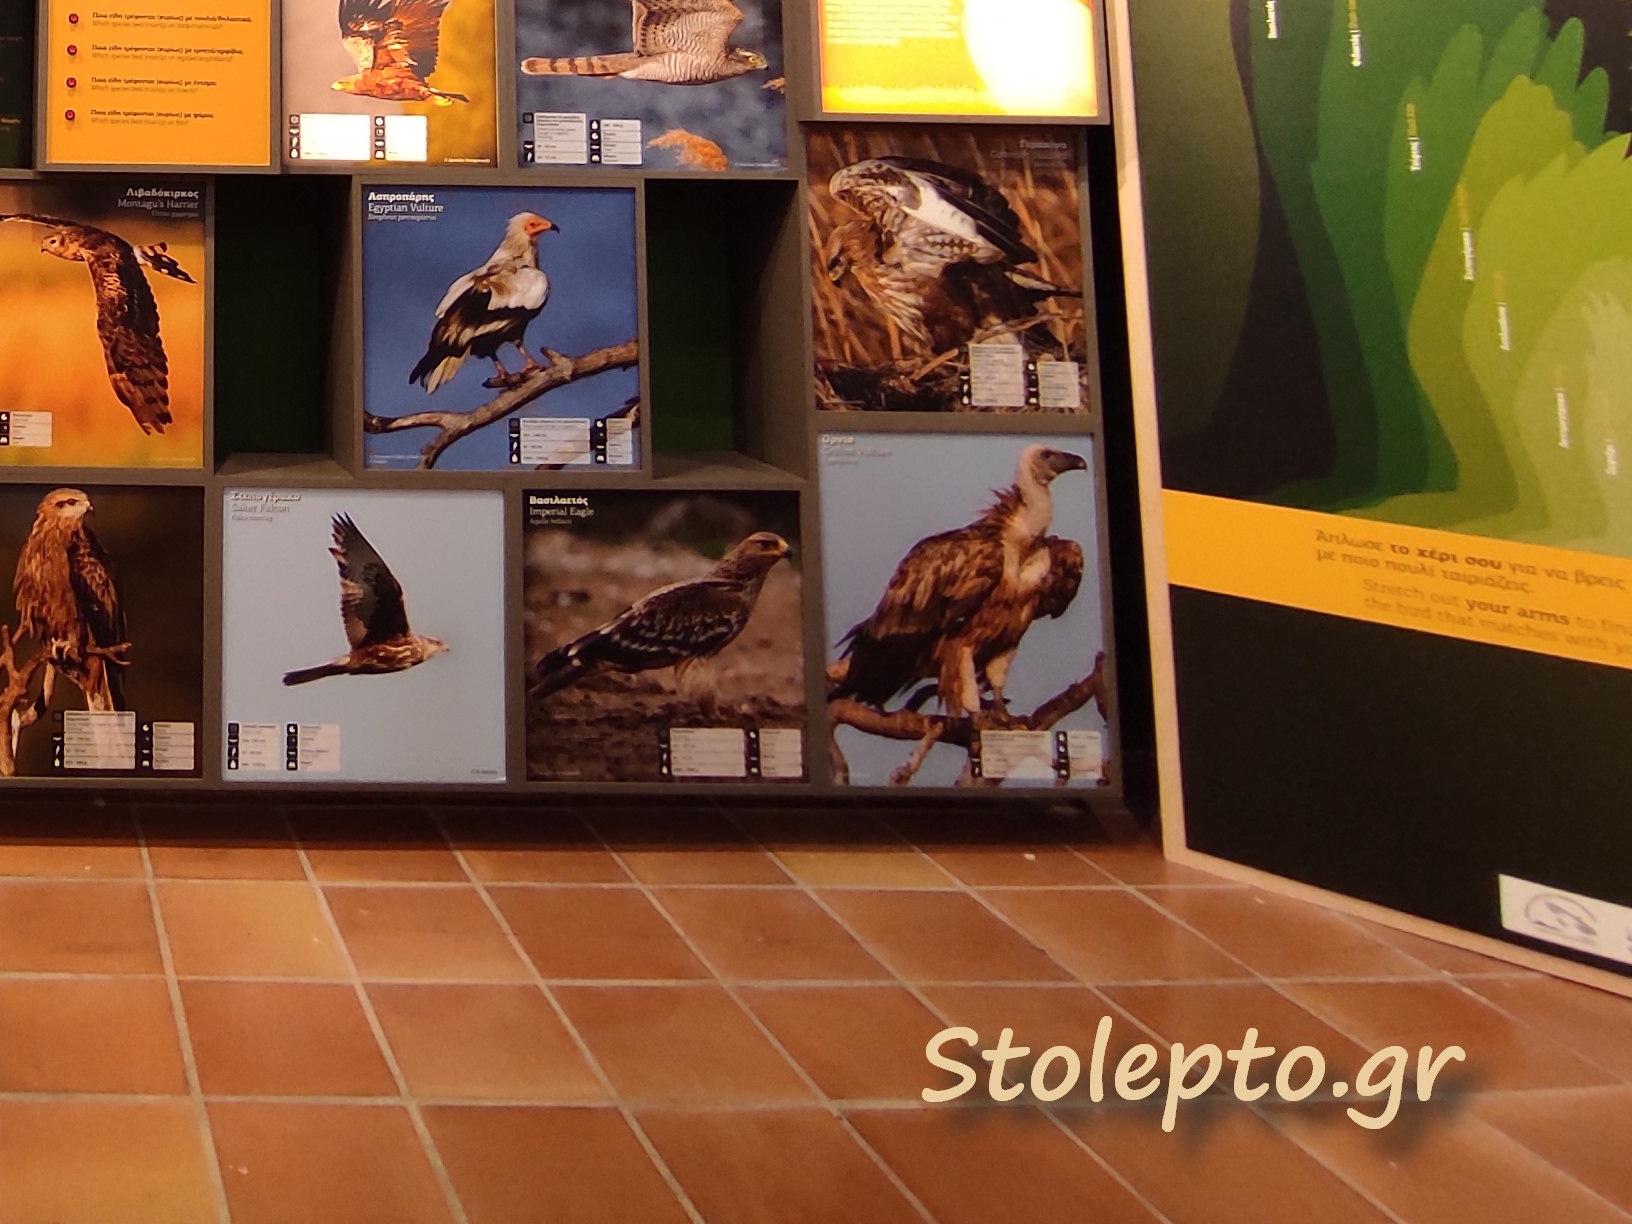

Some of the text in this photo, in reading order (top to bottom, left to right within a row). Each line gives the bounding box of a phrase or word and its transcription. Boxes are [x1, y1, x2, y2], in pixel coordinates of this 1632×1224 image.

[368, 203, 444, 214] Egyptian Vulture
[529, 495, 589, 506] Βασιλαετός
[1390, 543, 1410, 556] το
[1415, 547, 1458, 565] χέρι
[1464, 556, 1503, 570] σου
[1464, 598, 1512, 617] your
[1516, 607, 1570, 627] arms
